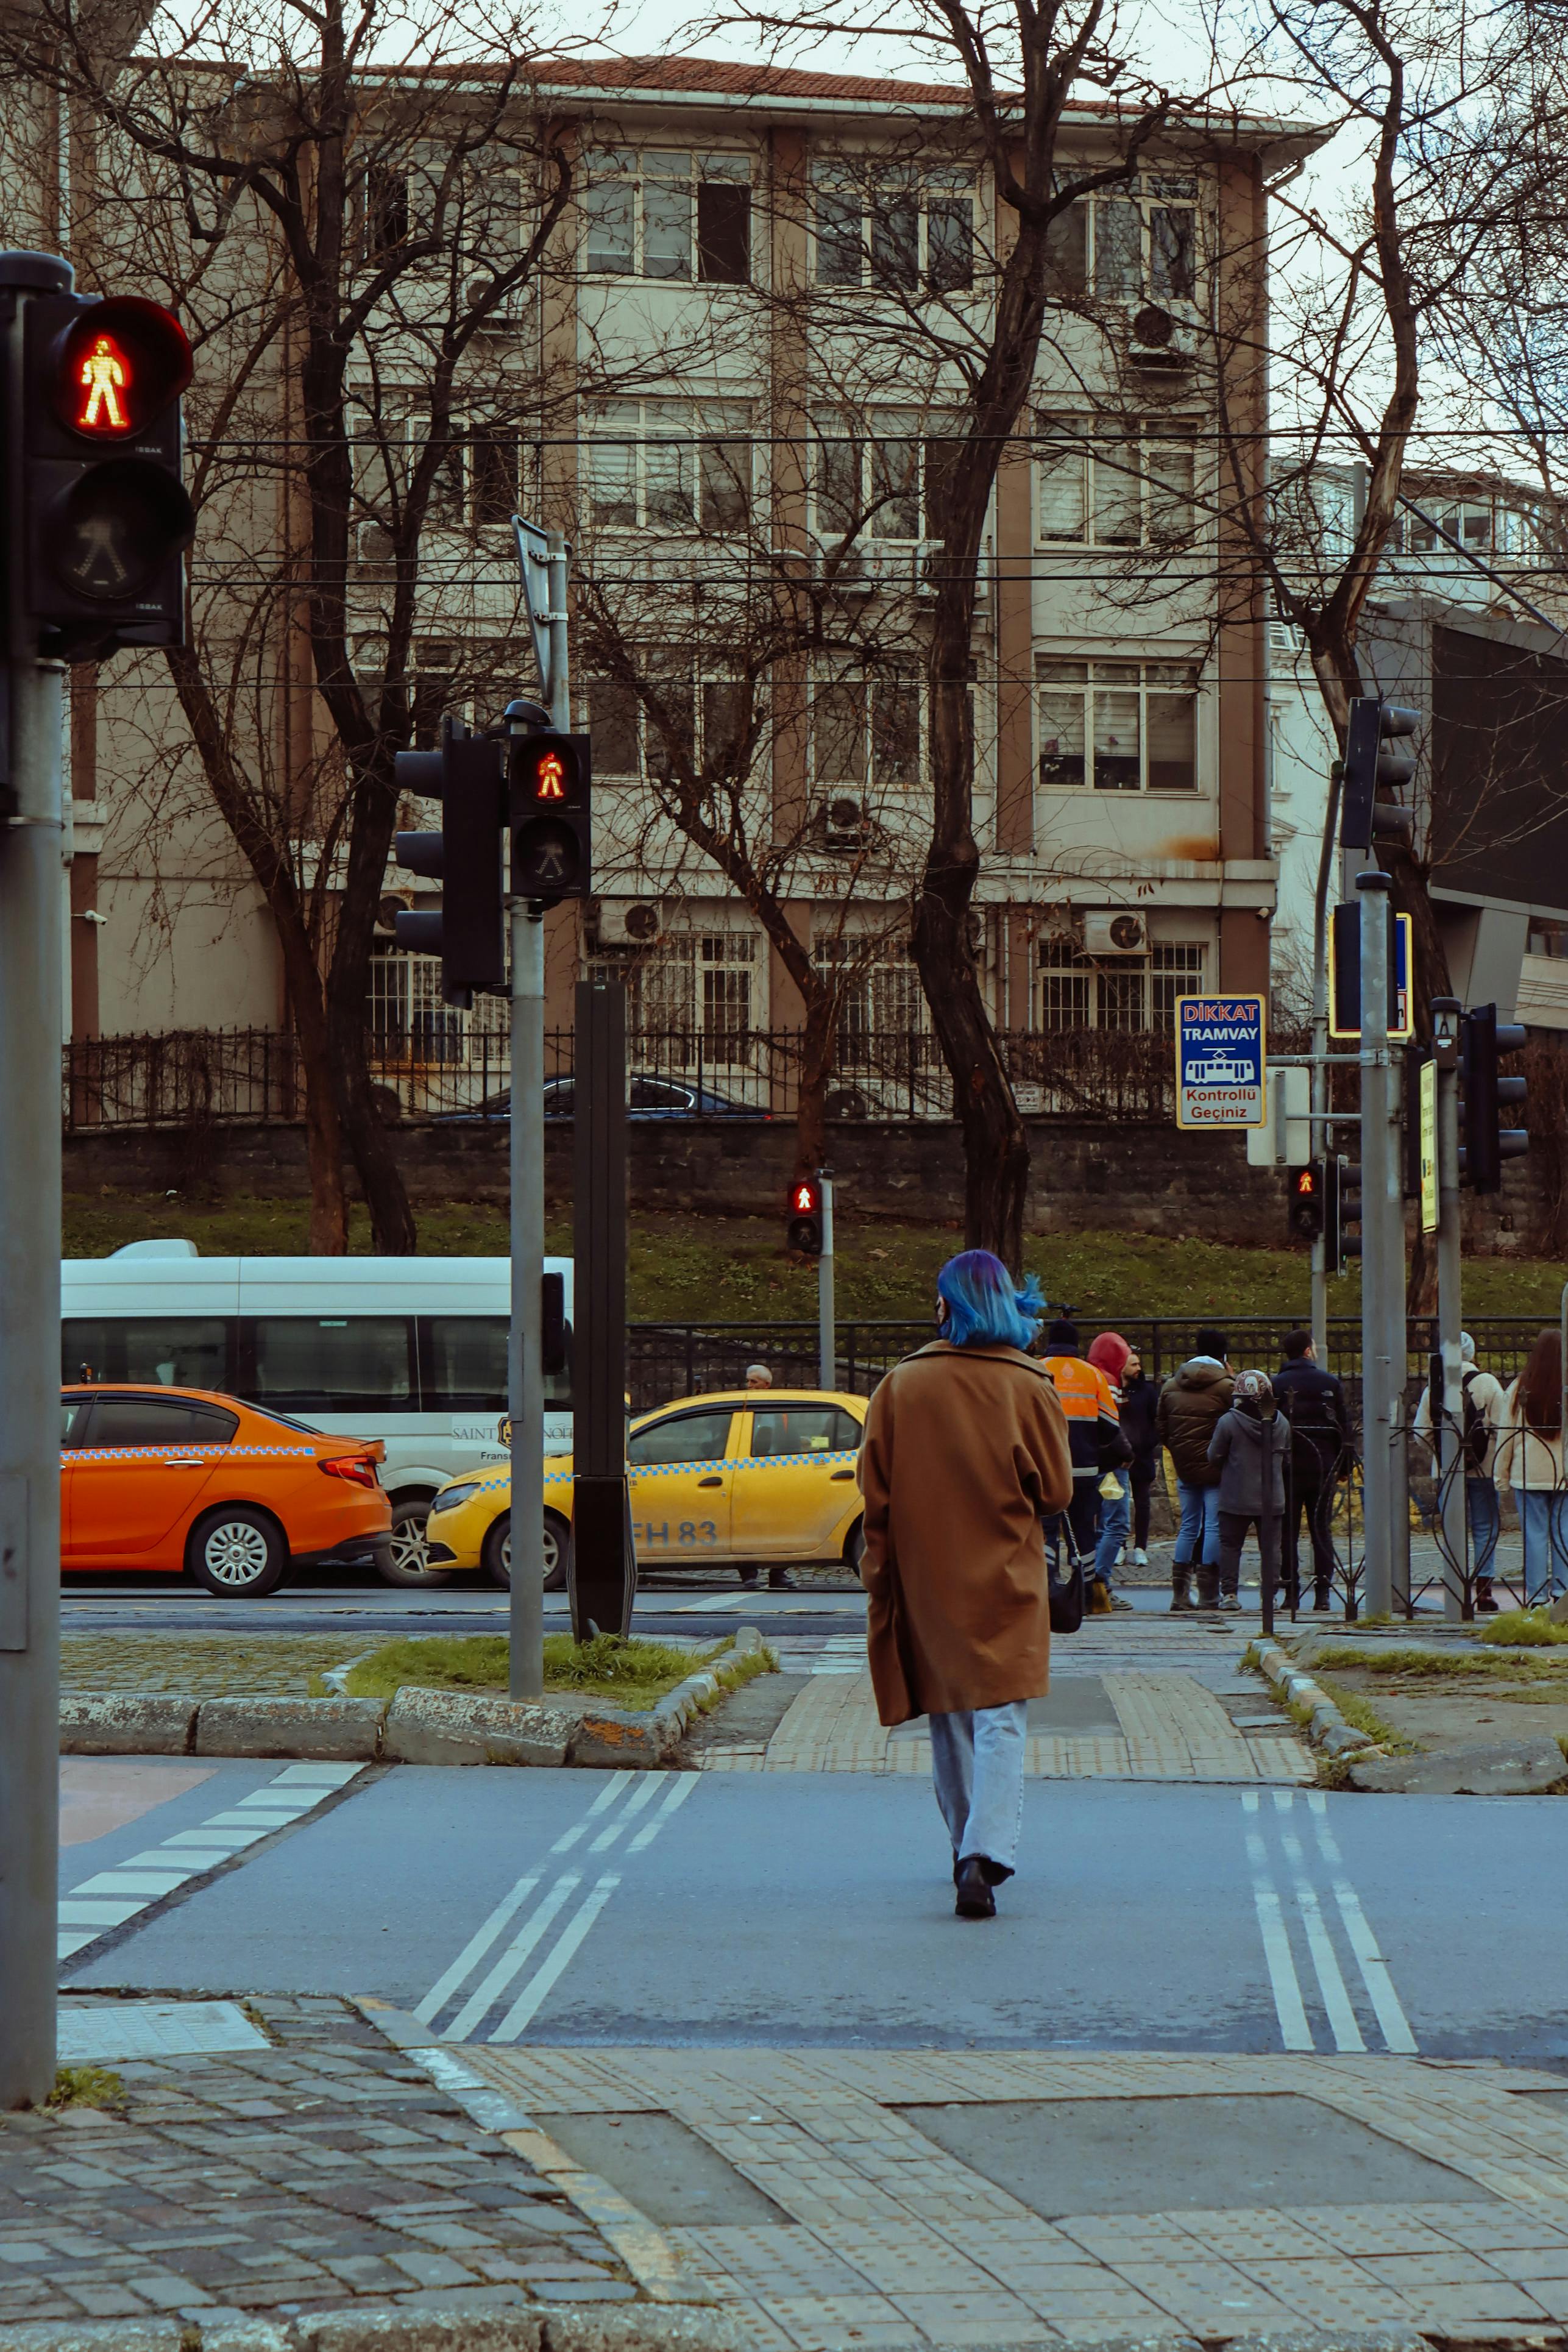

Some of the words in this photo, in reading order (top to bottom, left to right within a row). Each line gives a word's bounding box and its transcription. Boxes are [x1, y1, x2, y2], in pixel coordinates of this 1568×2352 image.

[1184, 1002, 1258, 1021] DİKKAT
[1183, 1028, 1258, 1040] TRAMVAY
[1187, 1089, 1256, 1101] Kontrollü
[1191, 1106, 1247, 1121] Geçiniz
[453, 1428, 496, 1440] SAINT
[679, 1521, 717, 1547] 83
